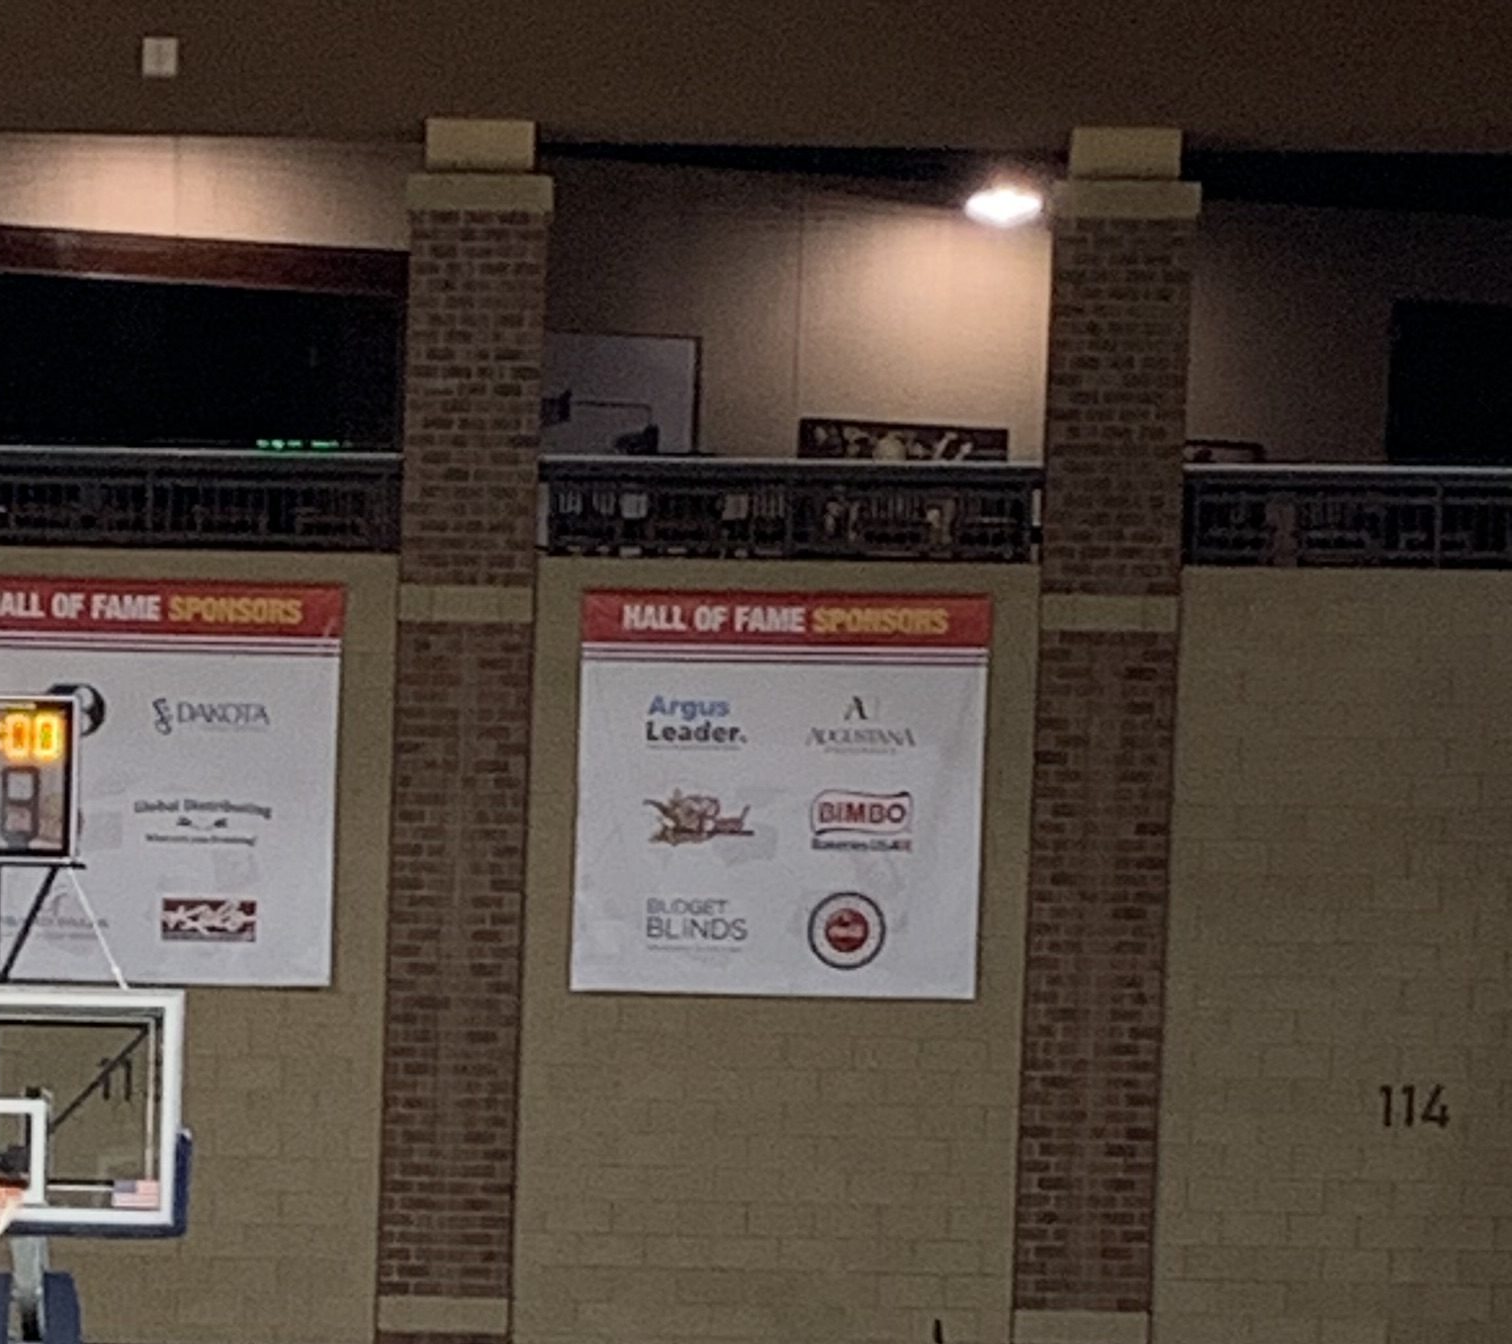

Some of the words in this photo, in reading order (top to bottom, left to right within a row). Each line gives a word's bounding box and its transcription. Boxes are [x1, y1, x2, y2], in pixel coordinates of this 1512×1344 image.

[51, 594, 84, 619] OF
[91, 595, 161, 621] FAME
[168, 596, 303, 625] SPONSORS
[623, 604, 687, 632] HALL
[694, 606, 727, 632] OF
[734, 607, 806, 633] FAME
[812, 608, 949, 635] SPONSORS
[648, 695, 731, 721] Argus
[818, 803, 907, 825] BIMBO
[646, 917, 749, 940] BLINDS
[1379, 1083, 1451, 1129] 114
